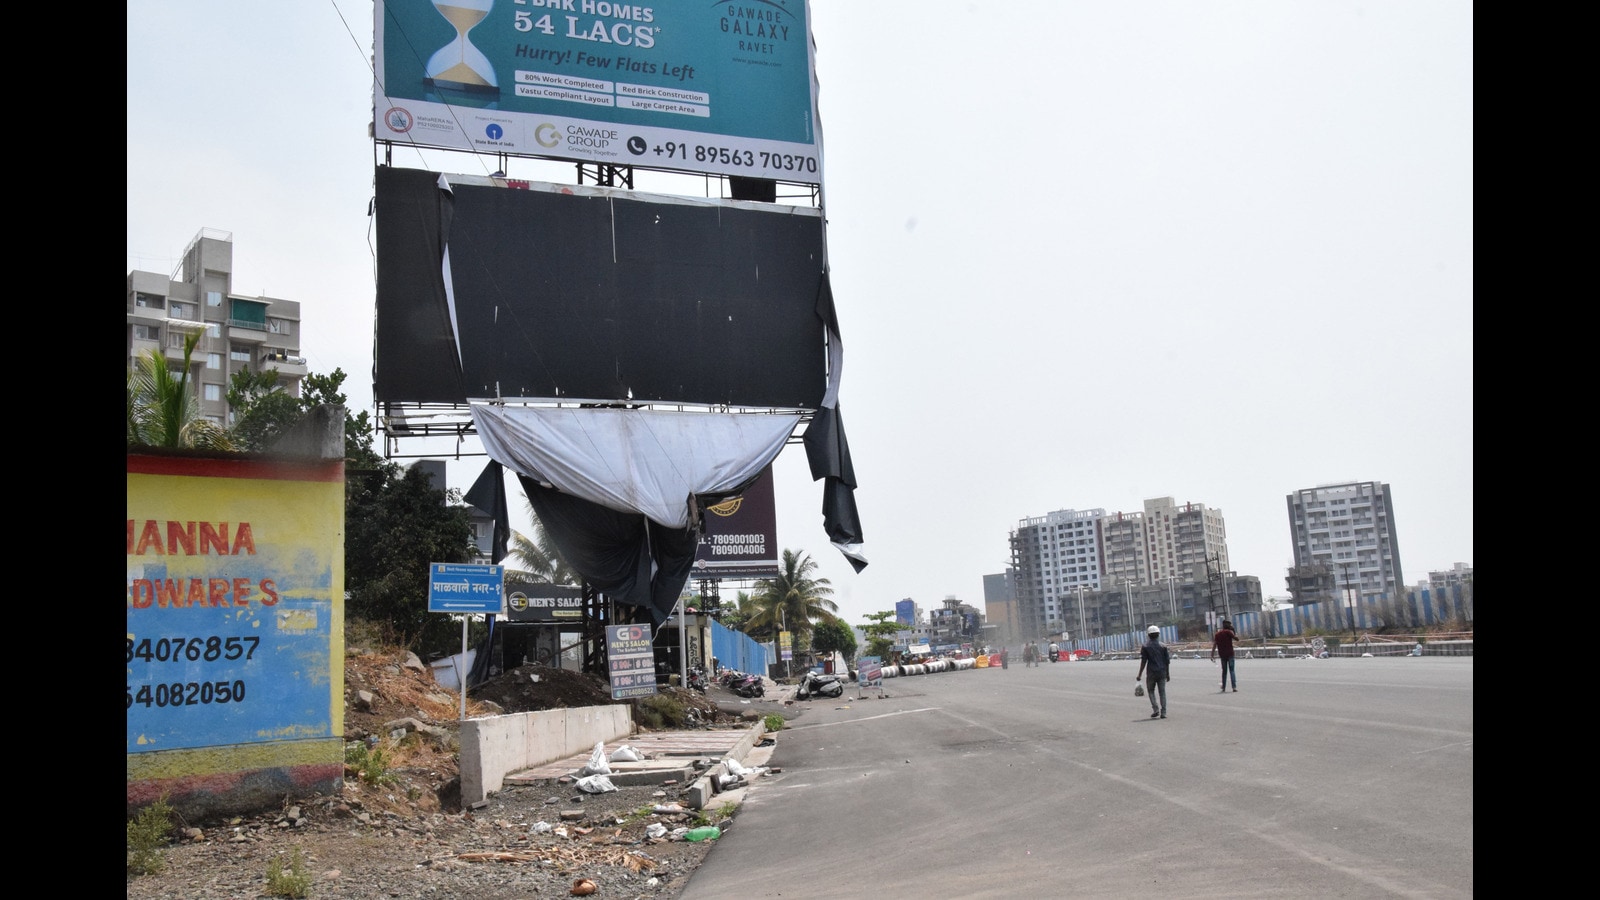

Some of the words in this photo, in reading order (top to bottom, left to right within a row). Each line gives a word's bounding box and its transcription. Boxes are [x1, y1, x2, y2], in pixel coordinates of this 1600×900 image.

[581, 0, 655, 23] HOMES
[728, 5, 781, 23] GAWADE
[514, 10, 555, 35] 54
[720, 16, 788, 41] GALAXY
[739, 40, 774, 54] RAVET
[515, 43, 571, 66] Hurry!
[576, 51, 612, 69] Few
[615, 57, 657, 74] Flats
[661, 62, 696, 82] Left
[524, 74, 541, 82] 80%
[541, 75, 563, 85] Work
[563, 79, 604, 91] Completed
[519, 87, 542, 96] Vastu
[543, 90, 583, 102] Compliant
[583, 93, 610, 105] Layout
[622, 86, 637, 94] Red
[637, 87, 657, 96] Brick
[657, 89, 704, 102] Construction
[631, 100, 652, 110] Large
[653, 103, 677, 112] Carpet
[678, 105, 696, 114] Area
[566, 125, 618, 140] GAWADE
[566, 135, 609, 148] GROUP
[653, 142, 687, 160] +91
[694, 145, 754, 167] 89563
[759, 151, 817, 173] 70370
[712, 534, 765, 545] 7809001003
[711, 545, 765, 555] 7809004006
[127, 578, 279, 609] DWARES
[528, 597, 555, 608] MEN'S
[617, 626, 642, 640] GD
[611, 641, 629, 649] MEN'S
[630, 639, 650, 647] SALON
